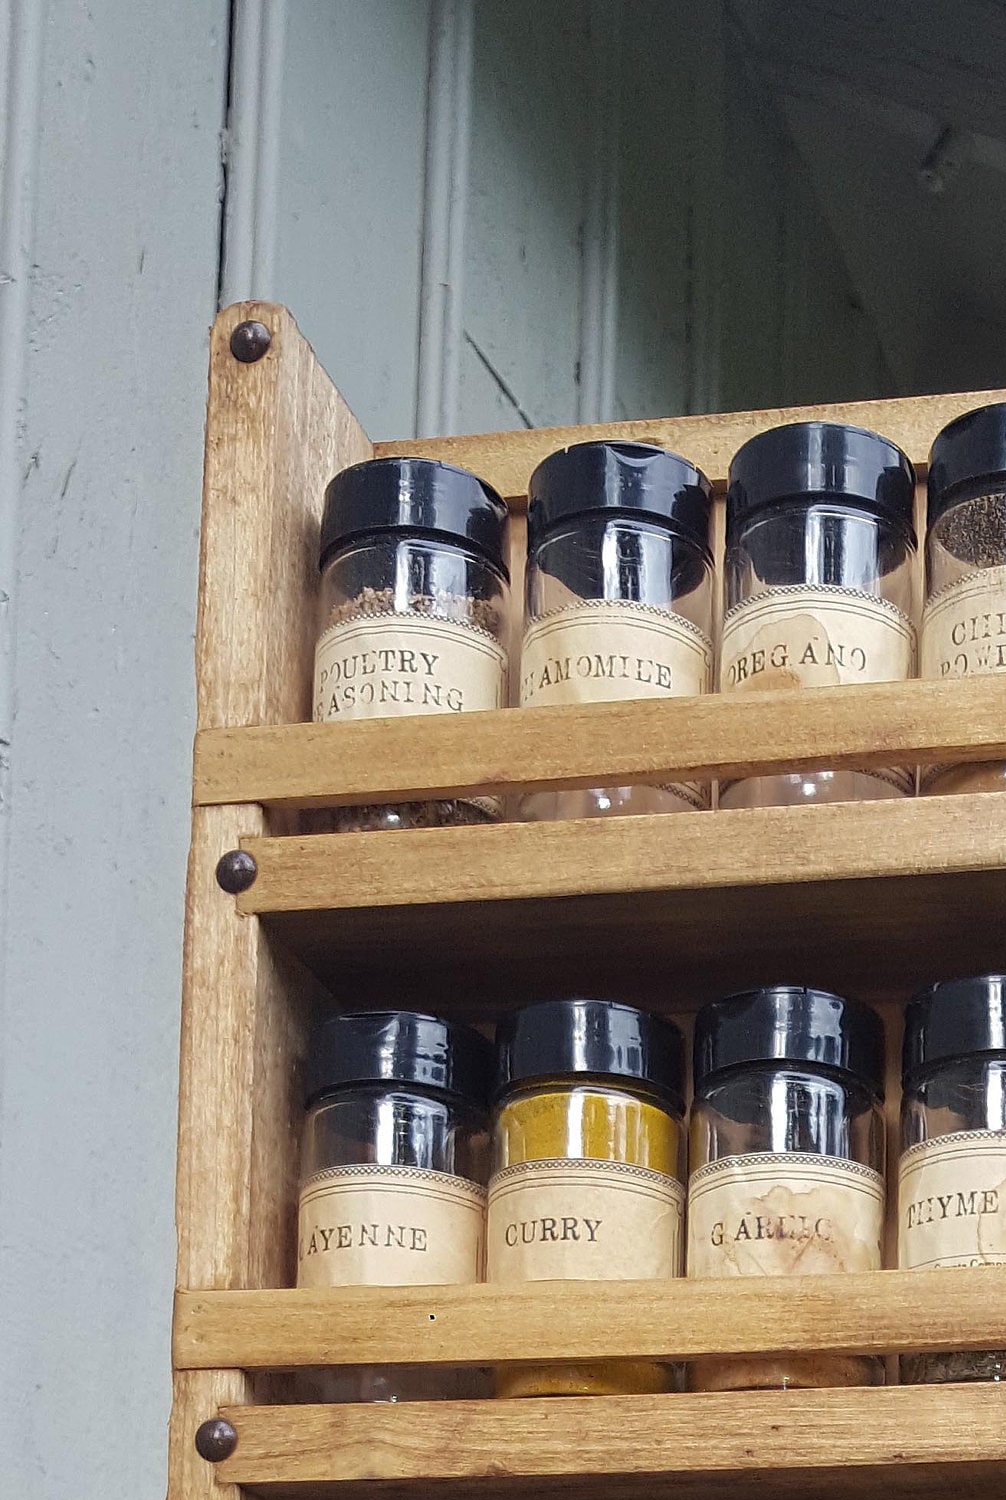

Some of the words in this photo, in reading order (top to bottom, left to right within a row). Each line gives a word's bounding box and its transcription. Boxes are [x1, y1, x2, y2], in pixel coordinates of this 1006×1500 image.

[319, 649, 440, 694] POULTRY
[522, 654, 672, 702] HAMOMILE
[727, 637, 867, 687] OREGANO
[313, 680, 464, 722] EASONING
[906, 1190, 999, 1229] THYME
[299, 1223, 428, 1262] AYENNE
[505, 1217, 603, 1247] CURRY
